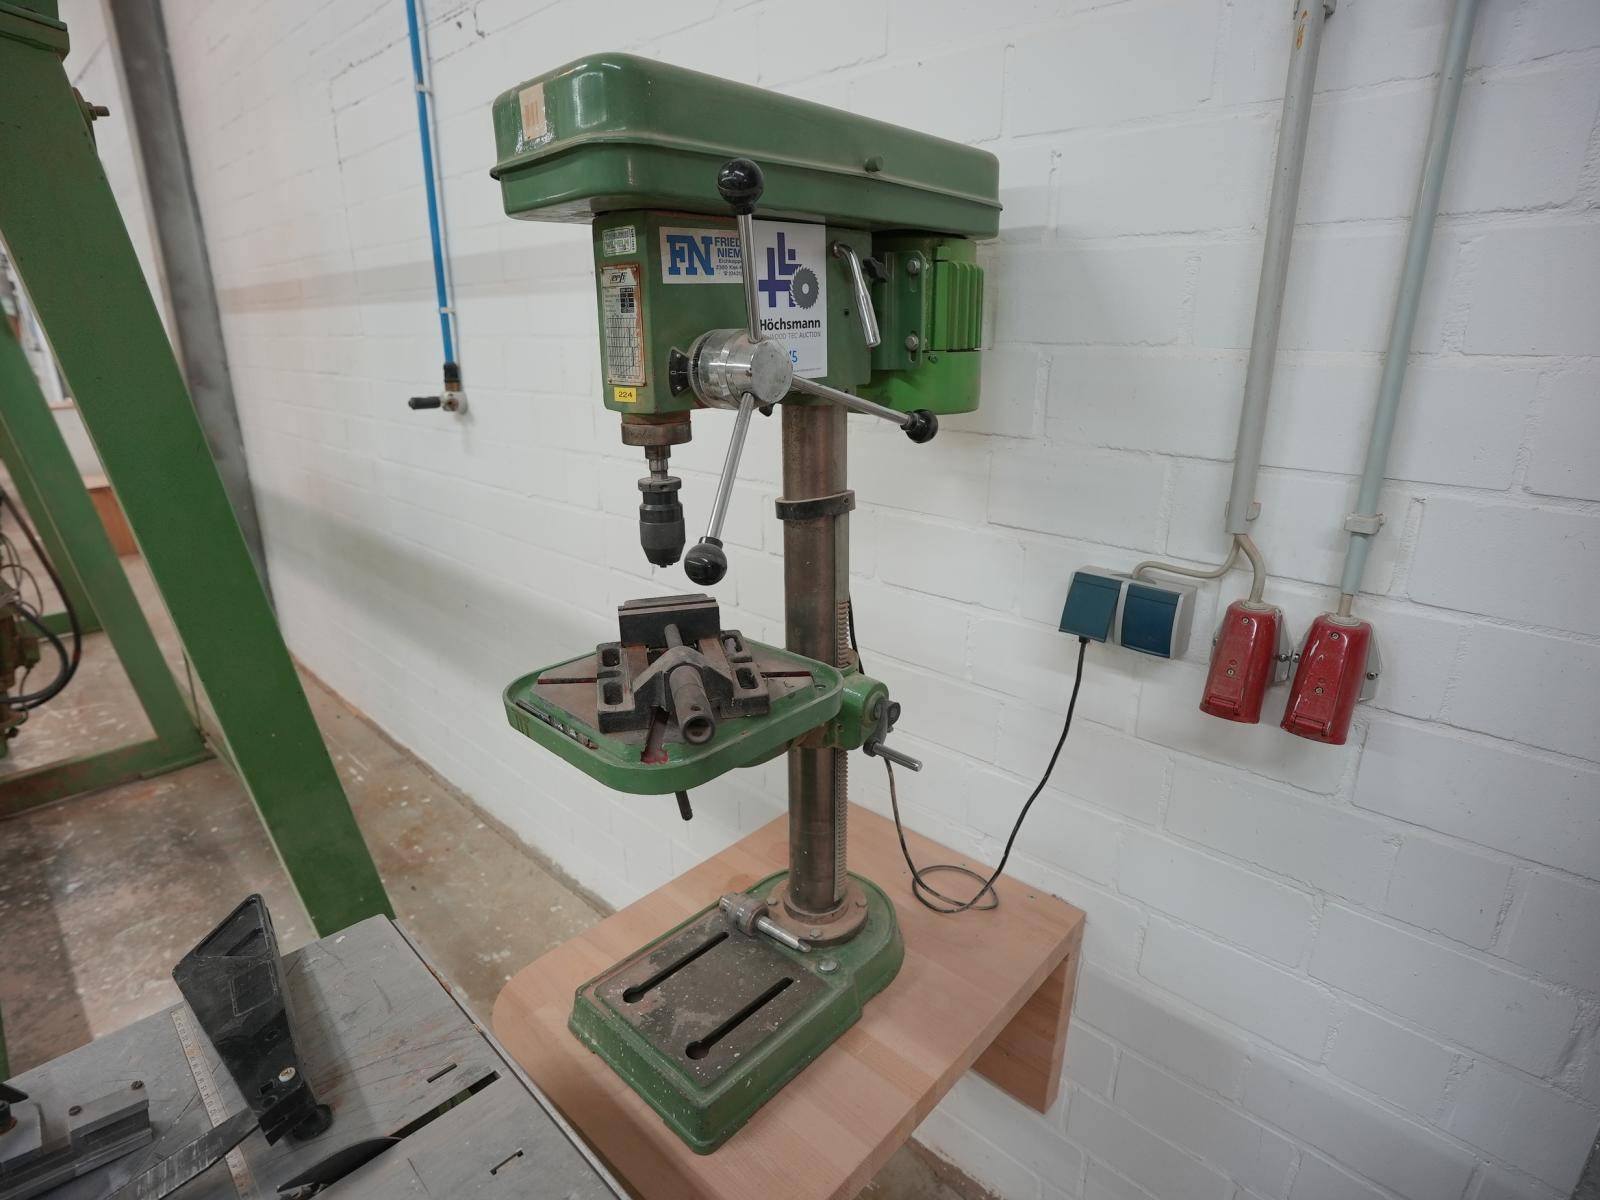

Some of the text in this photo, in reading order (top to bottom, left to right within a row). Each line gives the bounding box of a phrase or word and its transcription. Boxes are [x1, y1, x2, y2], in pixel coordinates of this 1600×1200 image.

[666, 235, 715, 275] FN
[760, 317, 821, 331] Höchsmann
[618, 391, 633, 399] 224
